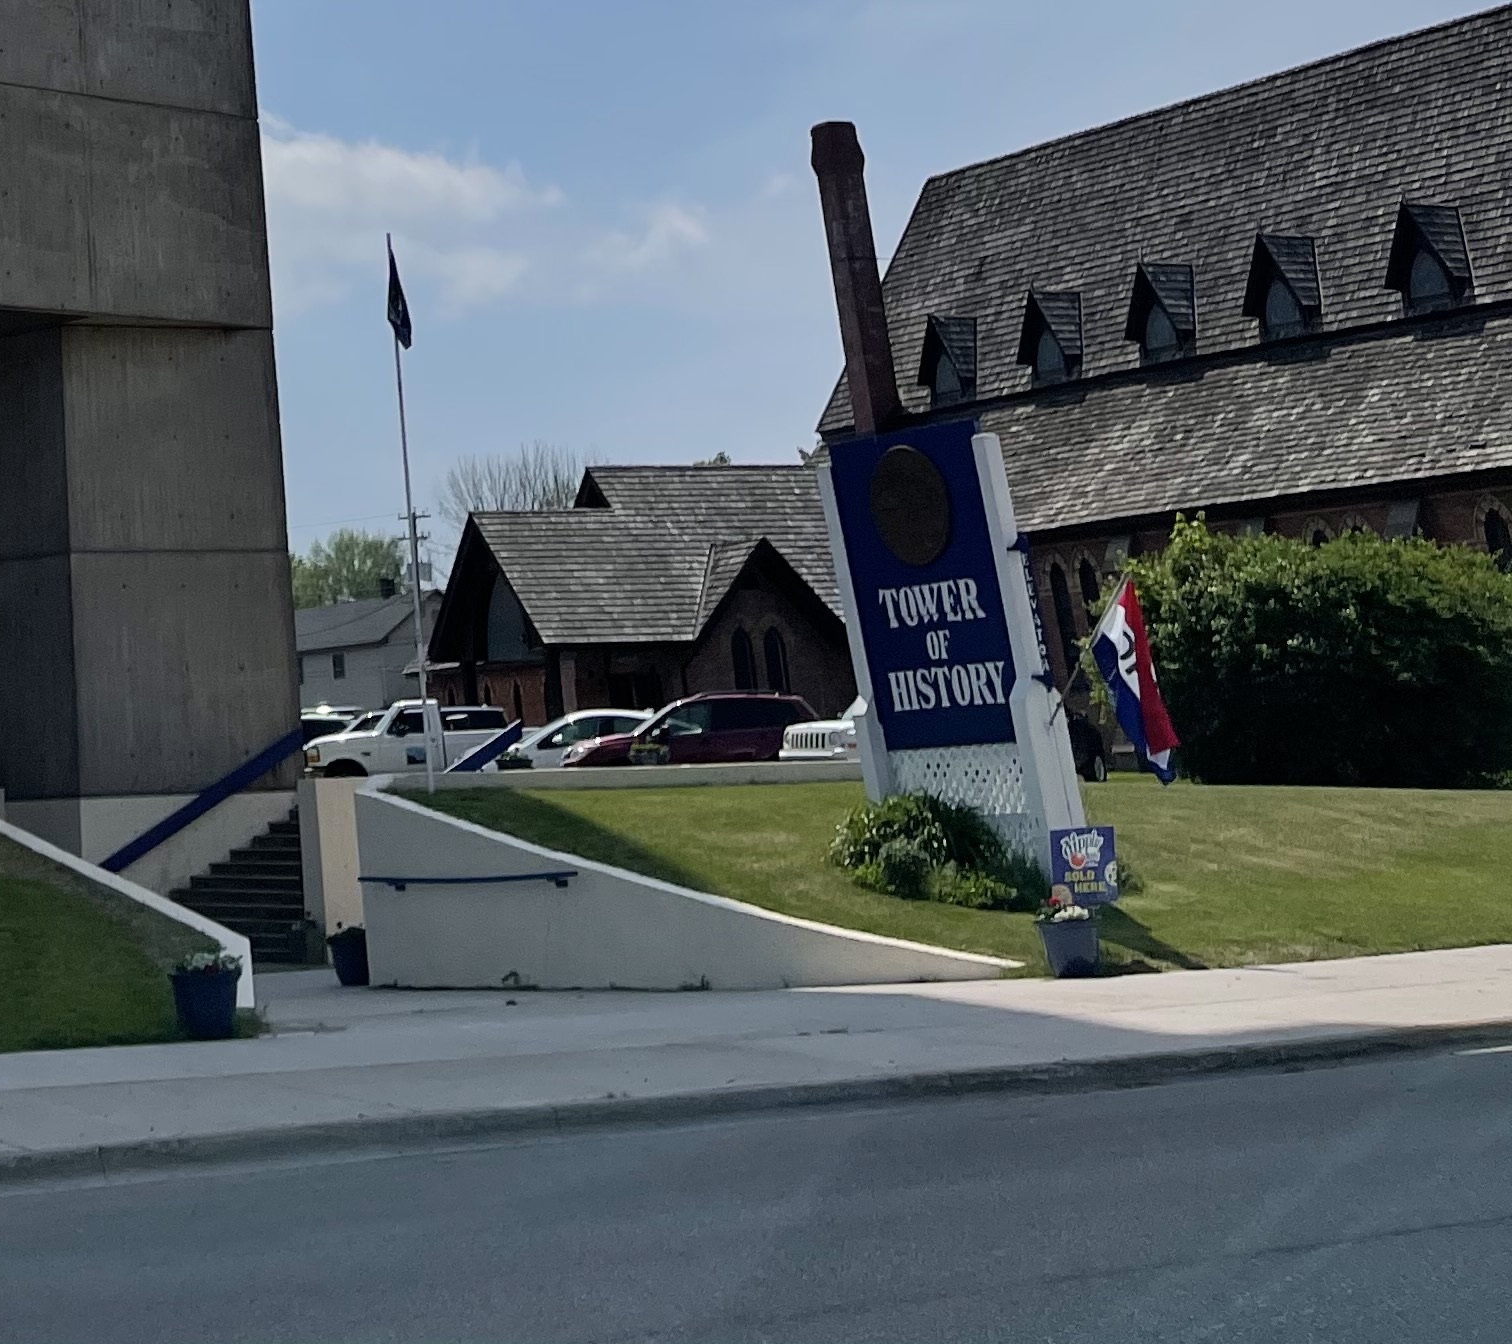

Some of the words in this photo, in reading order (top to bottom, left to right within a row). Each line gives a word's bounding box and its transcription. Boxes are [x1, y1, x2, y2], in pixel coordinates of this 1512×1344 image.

[878, 578, 986, 629] TOWER
[926, 629, 950, 660] OF
[888, 661, 1006, 712] HISTORY
